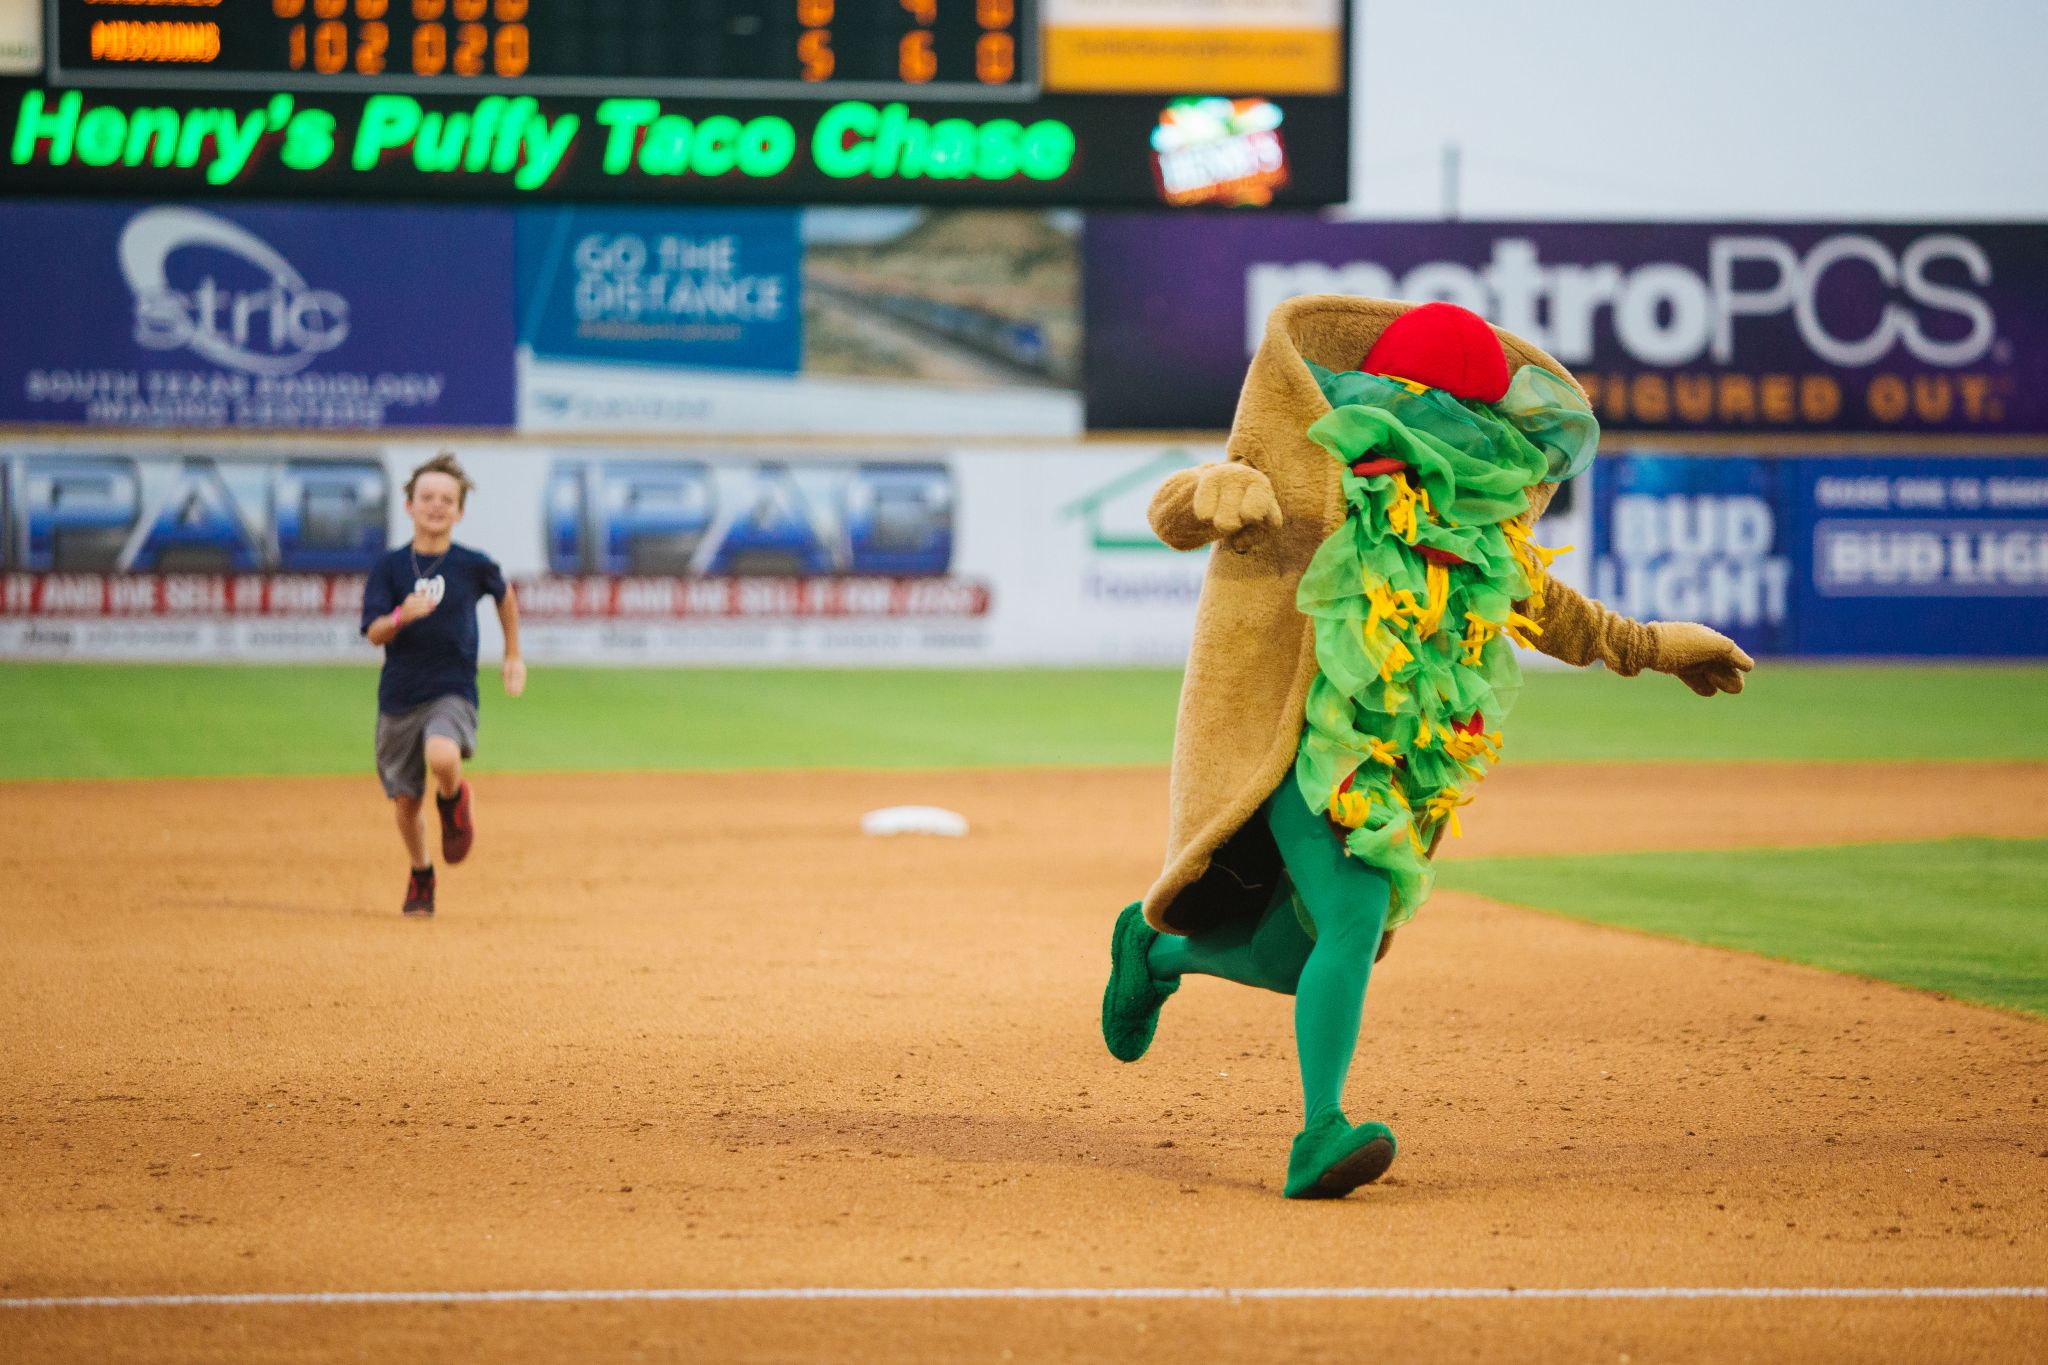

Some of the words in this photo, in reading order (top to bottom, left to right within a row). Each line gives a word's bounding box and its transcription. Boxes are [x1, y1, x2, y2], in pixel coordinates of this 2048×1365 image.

[899, 29, 938, 84] 6
[12, 90, 336, 184] Henry's
[352, 96, 579, 190] Puffy
[597, 99, 796, 177] Taco
[811, 101, 1076, 180] Chase
[575, 234, 647, 274] GO
[659, 235, 739, 274] THE
[575, 273, 785, 322] DISTANCE
[1613, 493, 1776, 554] BUD
[1831, 530, 1944, 586] BUD
[1597, 552, 1794, 628] LIGHT
